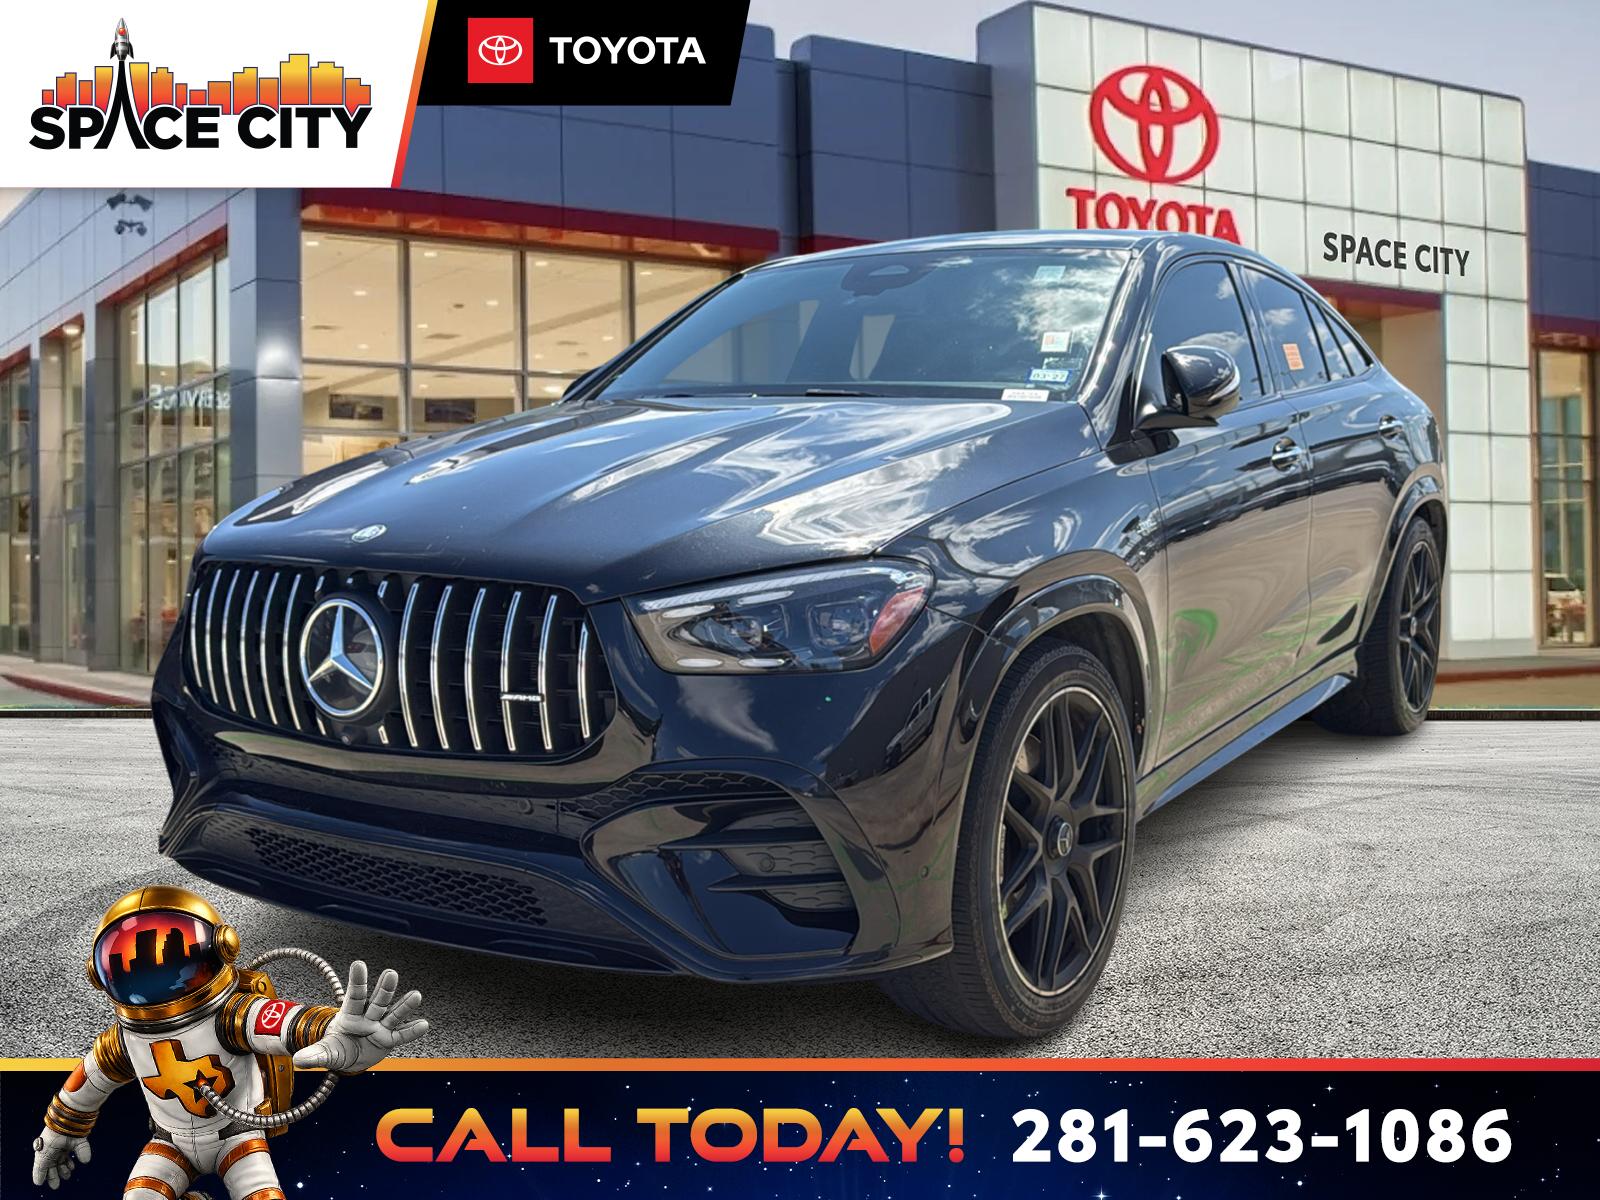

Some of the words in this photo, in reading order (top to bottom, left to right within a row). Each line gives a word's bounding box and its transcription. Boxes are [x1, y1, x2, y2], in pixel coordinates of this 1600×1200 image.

[1066, 188, 1241, 245] TOYOTA
[1323, 232, 1407, 270] SPACE
[1414, 244, 1470, 277] CITY
